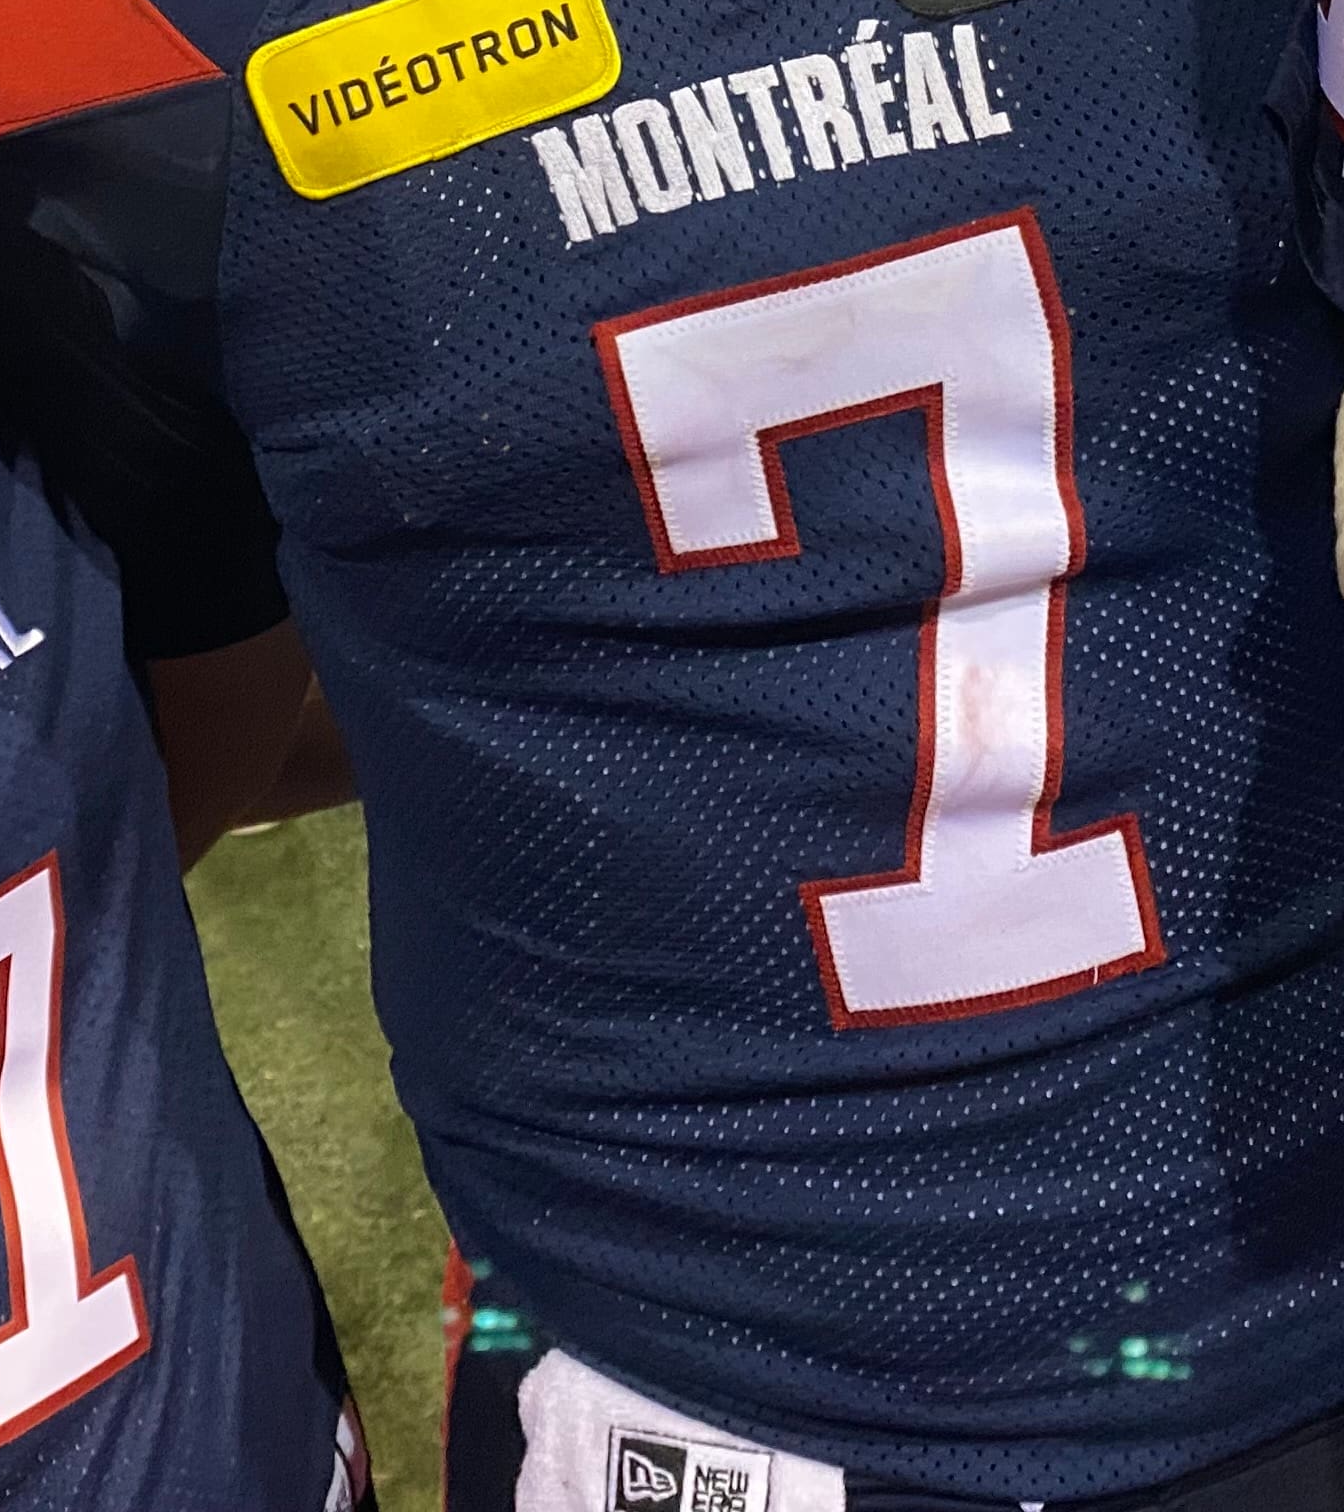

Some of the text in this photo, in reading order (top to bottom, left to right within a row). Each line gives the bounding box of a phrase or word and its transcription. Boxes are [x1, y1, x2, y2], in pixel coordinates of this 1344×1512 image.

[289, 3, 581, 137] VIDÉOTRON
[531, 19, 1012, 246] MONTRÉAL
[589, 205, 1168, 1031] 7
[693, 1463, 750, 1496] NEW
